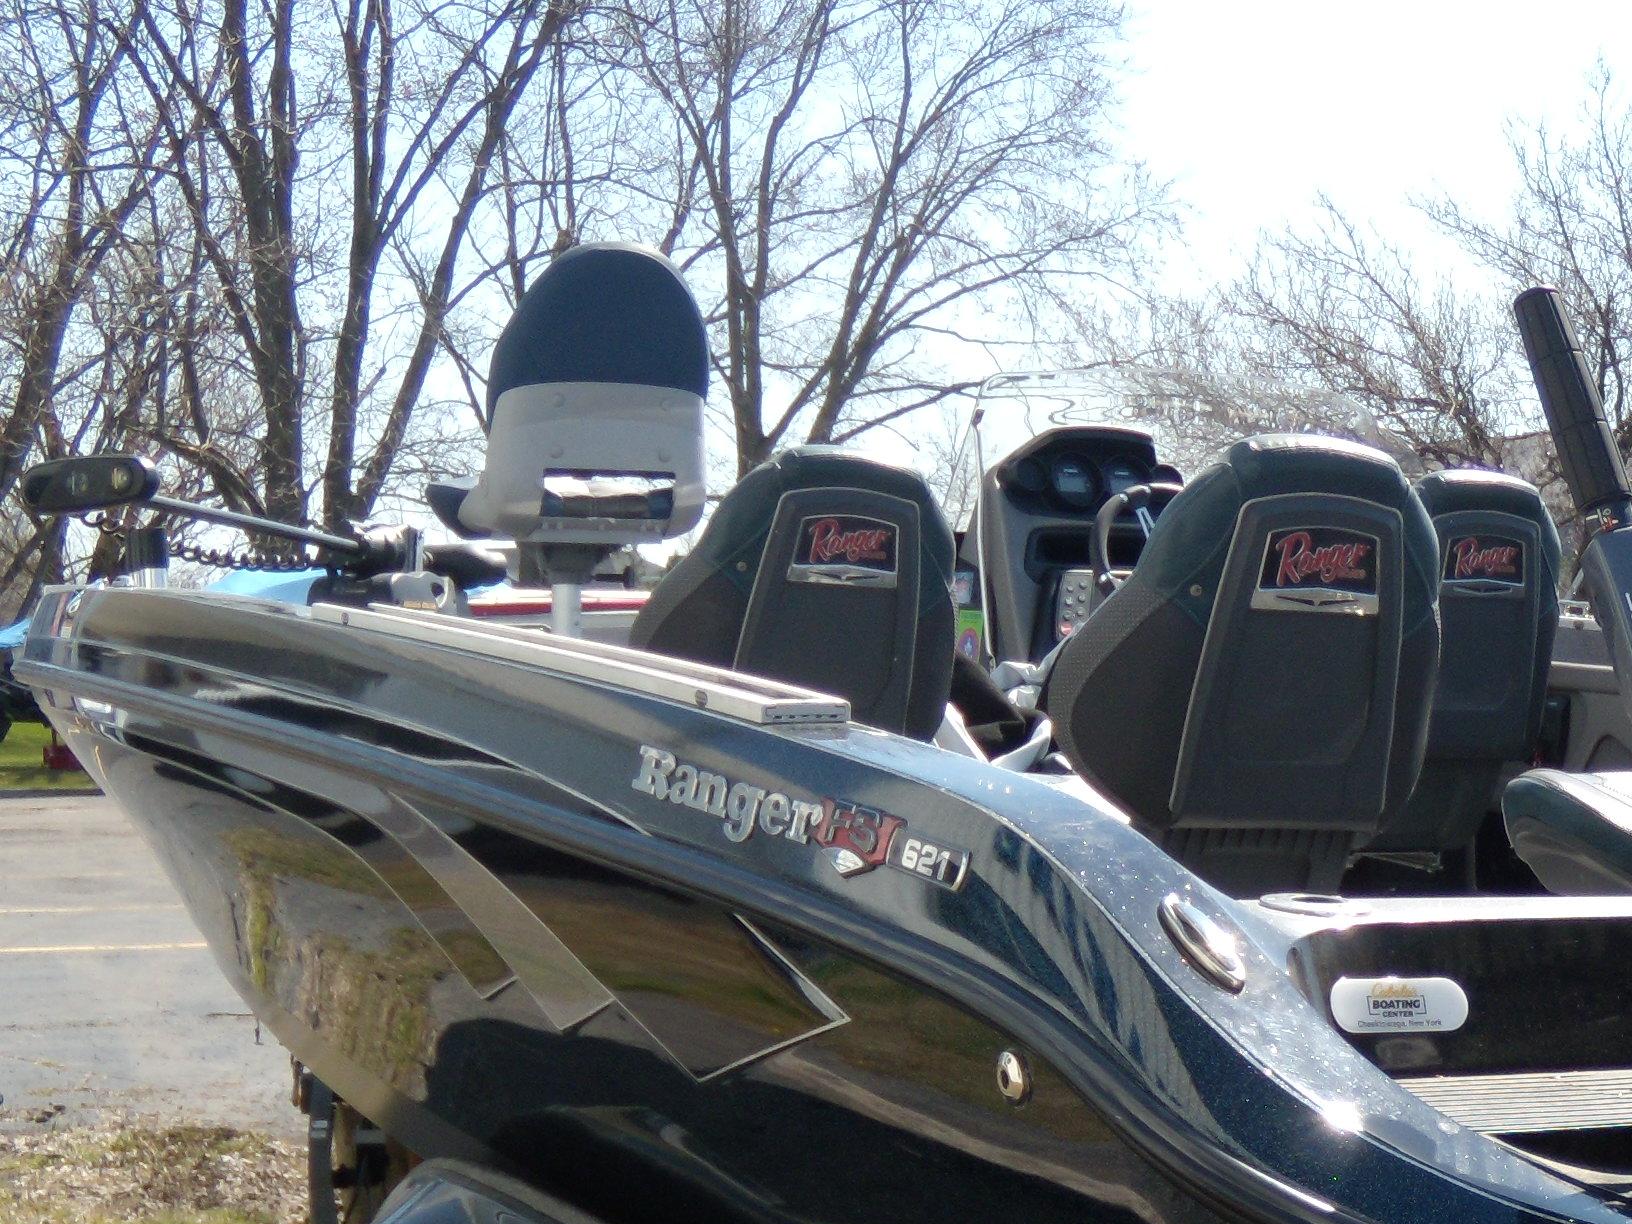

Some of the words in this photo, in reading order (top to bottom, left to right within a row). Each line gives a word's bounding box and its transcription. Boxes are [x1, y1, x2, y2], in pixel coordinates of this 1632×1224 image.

[808, 517, 892, 564] Ranger
[1275, 531, 1371, 587] Ranger
[1453, 537, 1516, 579] Ranger
[631, 744, 824, 843] Ranger
[901, 837, 951, 881] 621
[1372, 1000, 1421, 1010] BOATING
[1382, 1010, 1414, 1018] CENTER
